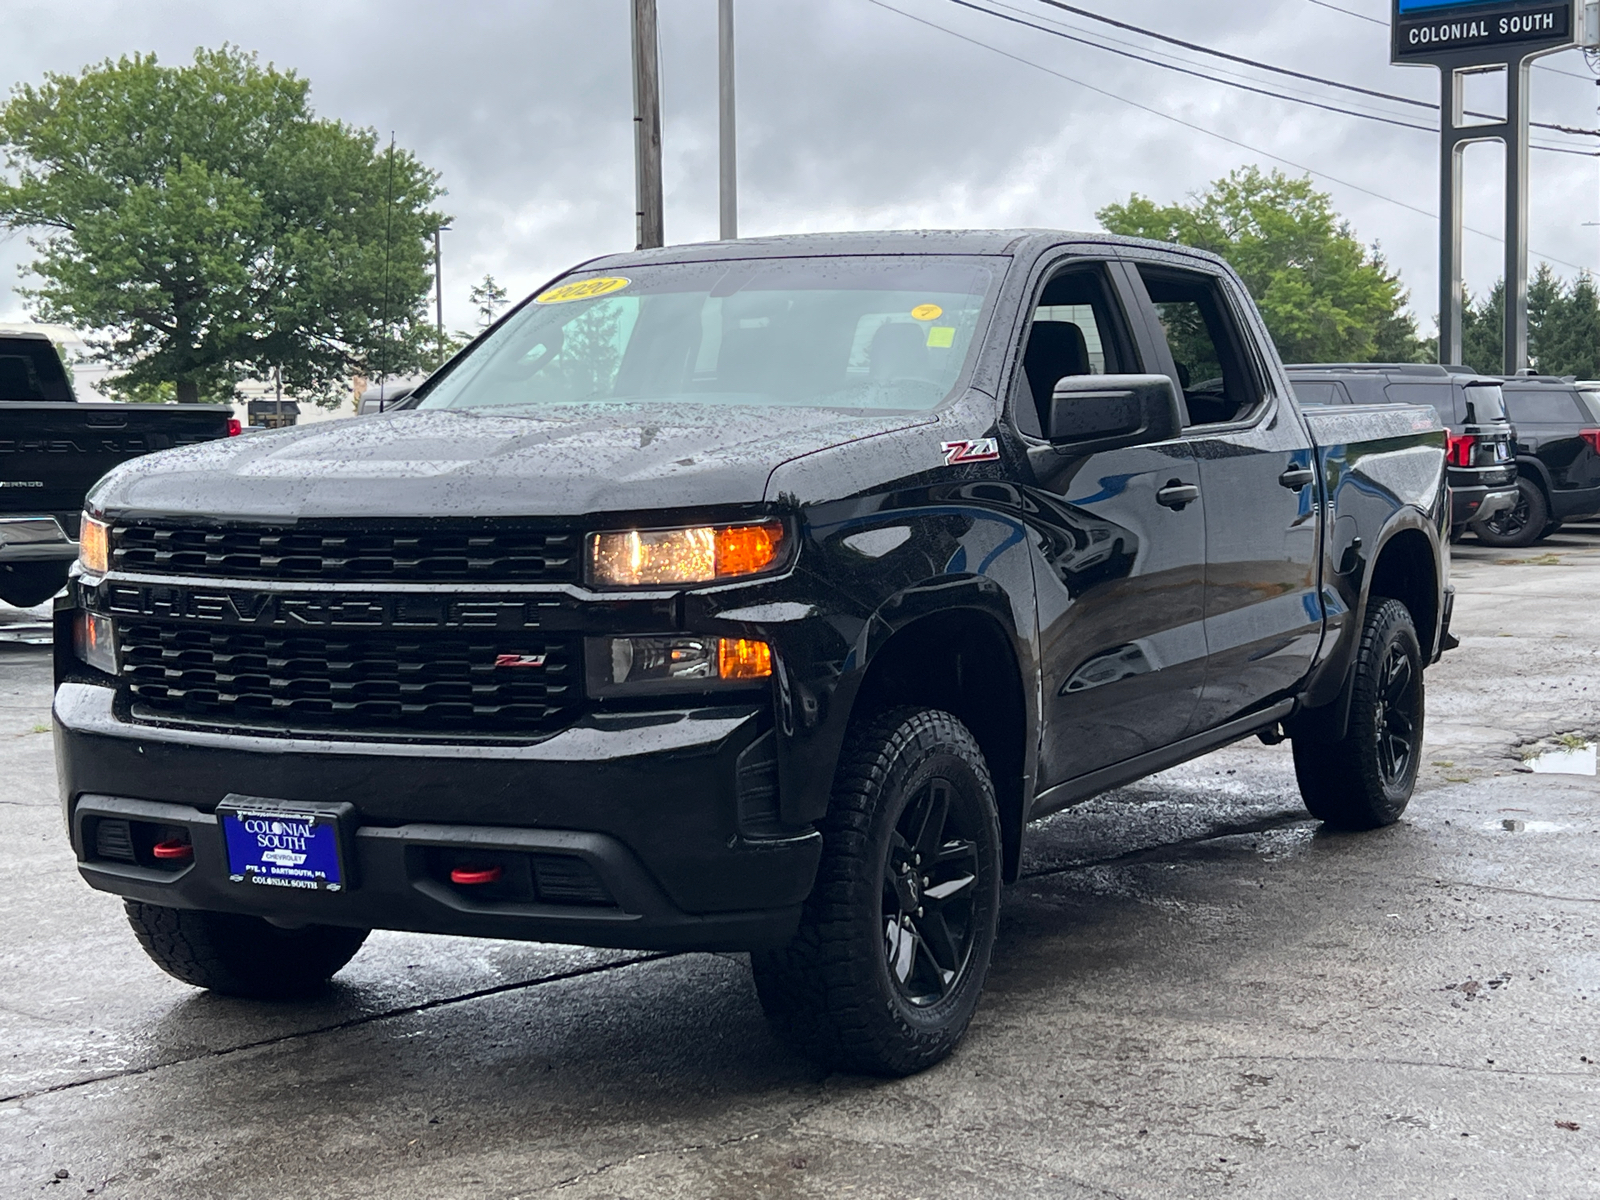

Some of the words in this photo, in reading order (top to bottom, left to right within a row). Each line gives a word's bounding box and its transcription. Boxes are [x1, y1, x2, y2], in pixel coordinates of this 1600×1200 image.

[1409, 20, 1489, 44] COLONIAL
[1499, 13, 1553, 34] SOUTH
[544, 280, 618, 302] 2020
[940, 438, 1000, 466] Z71
[109, 588, 561, 627] CHEVROLET
[245, 820, 315, 838] COLONIAL
[257, 834, 306, 850] SOUTH
[265, 853, 302, 862] CHEVROLET
[252, 876, 290, 887] COLONIAL
[291, 878, 318, 890] SOUTH
